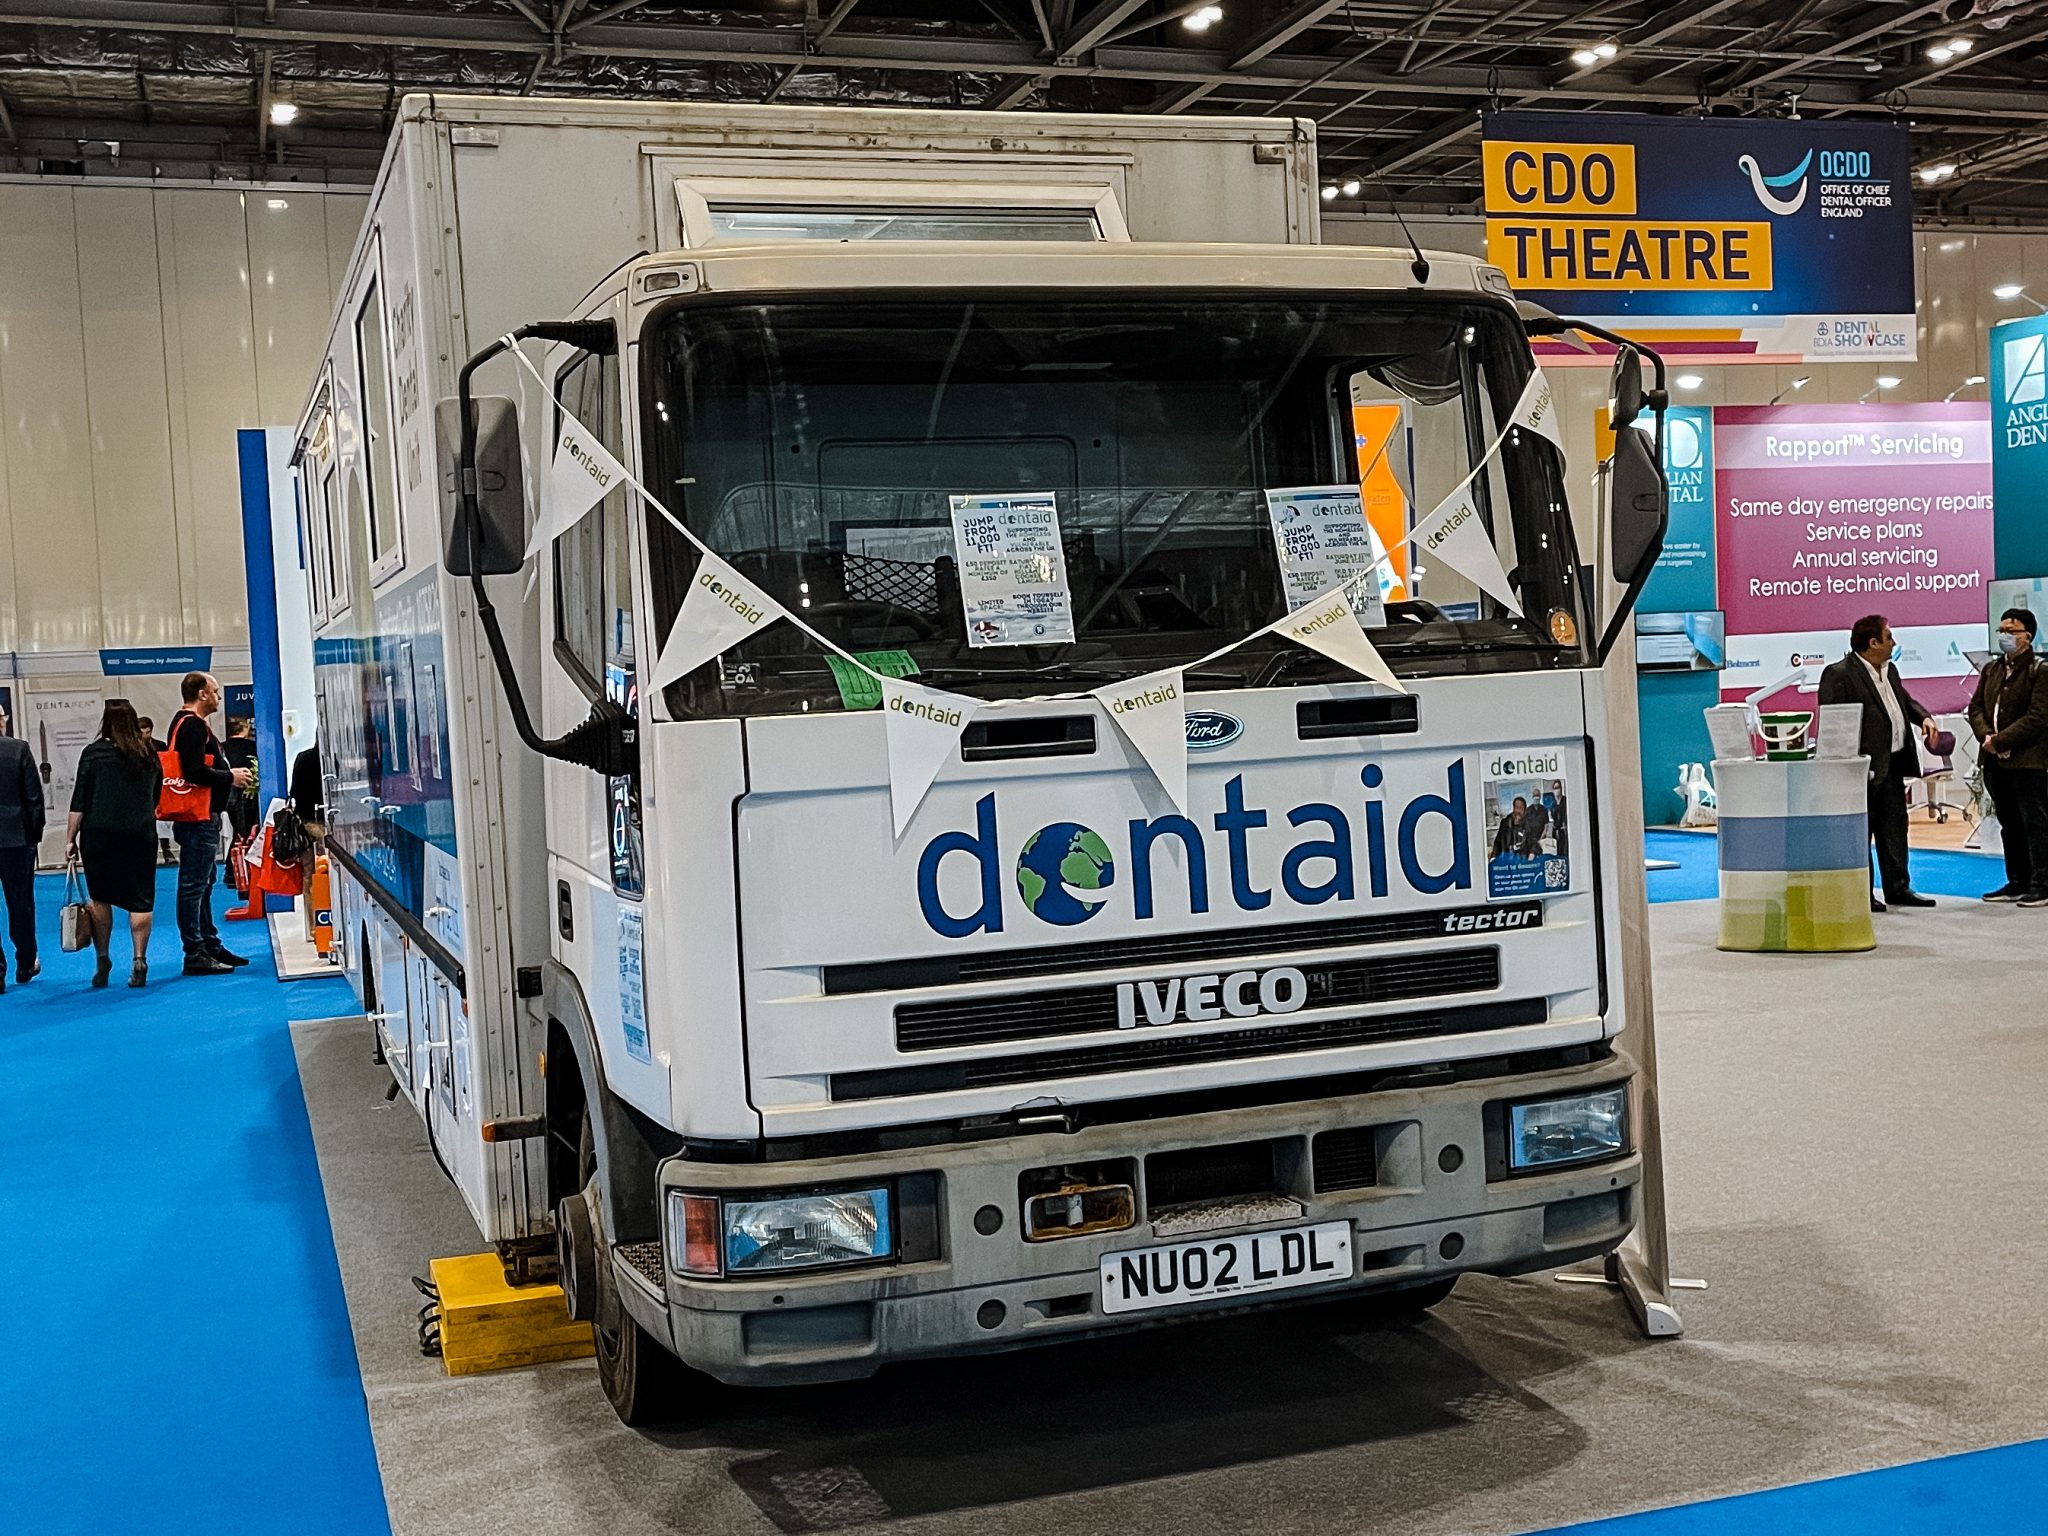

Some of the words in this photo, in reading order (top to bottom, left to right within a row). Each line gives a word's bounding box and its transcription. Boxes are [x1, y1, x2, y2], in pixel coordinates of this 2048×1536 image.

[1820, 151, 1870, 177] OCDO
[1505, 151, 1615, 205] CDO
[1820, 184, 1851, 195] OFFICE
[1852, 185, 1864, 195] OF
[1865, 185, 1890, 195] CHIEF
[1820, 196, 1855, 206] DENTAL
[1855, 197, 1892, 206] OFFICER
[1821, 207, 1863, 218] ENGLAND
[1504, 226, 1750, 280] THEATRE
[1834, 321, 1881, 333] DENTAL
[2006, 404, 2048, 427] ANGL
[1870, 433, 1964, 459] Servicing
[2006, 423, 2048, 448] DEN
[563, 436, 610, 487] dentaid
[1667, 471, 1702, 485] LIAN
[1669, 487, 1703, 503] TAL
[1730, 497, 1783, 518] Same
[1788, 496, 1824, 519] day
[1829, 494, 1932, 517] emergency
[1935, 491, 1994, 515] repairs
[963, 516, 993, 528] JUMP
[964, 525, 997, 537] FROM
[1284, 525, 1312, 537] JUMP
[1427, 503, 1472, 549] dentaid
[1806, 521, 1872, 543] Service
[1876, 520, 1923, 543] plans
[1286, 533, 1315, 546] FROM
[1793, 548, 1857, 569] Annual
[1862, 546, 1938, 569] servicing
[1749, 577, 1822, 598] Remote
[1826, 573, 1911, 595] technical
[1915, 570, 1981, 593] support
[700, 574, 764, 624] dentaid
[1292, 604, 1347, 639] dentaid
[236, 692, 255, 700] JUV
[1113, 684, 1177, 714] dentaid
[890, 695, 961, 727] dentaid
[1185, 718, 1223, 738] Ford
[1490, 753, 1558, 776] dentaid
[917, 757, 1472, 938] dentaid
[1443, 906, 1540, 932] tector
[1117, 966, 1309, 1029] IVECO
[1121, 1243, 1239, 1299] NU02
[1252, 1230, 1334, 1281] LDL
